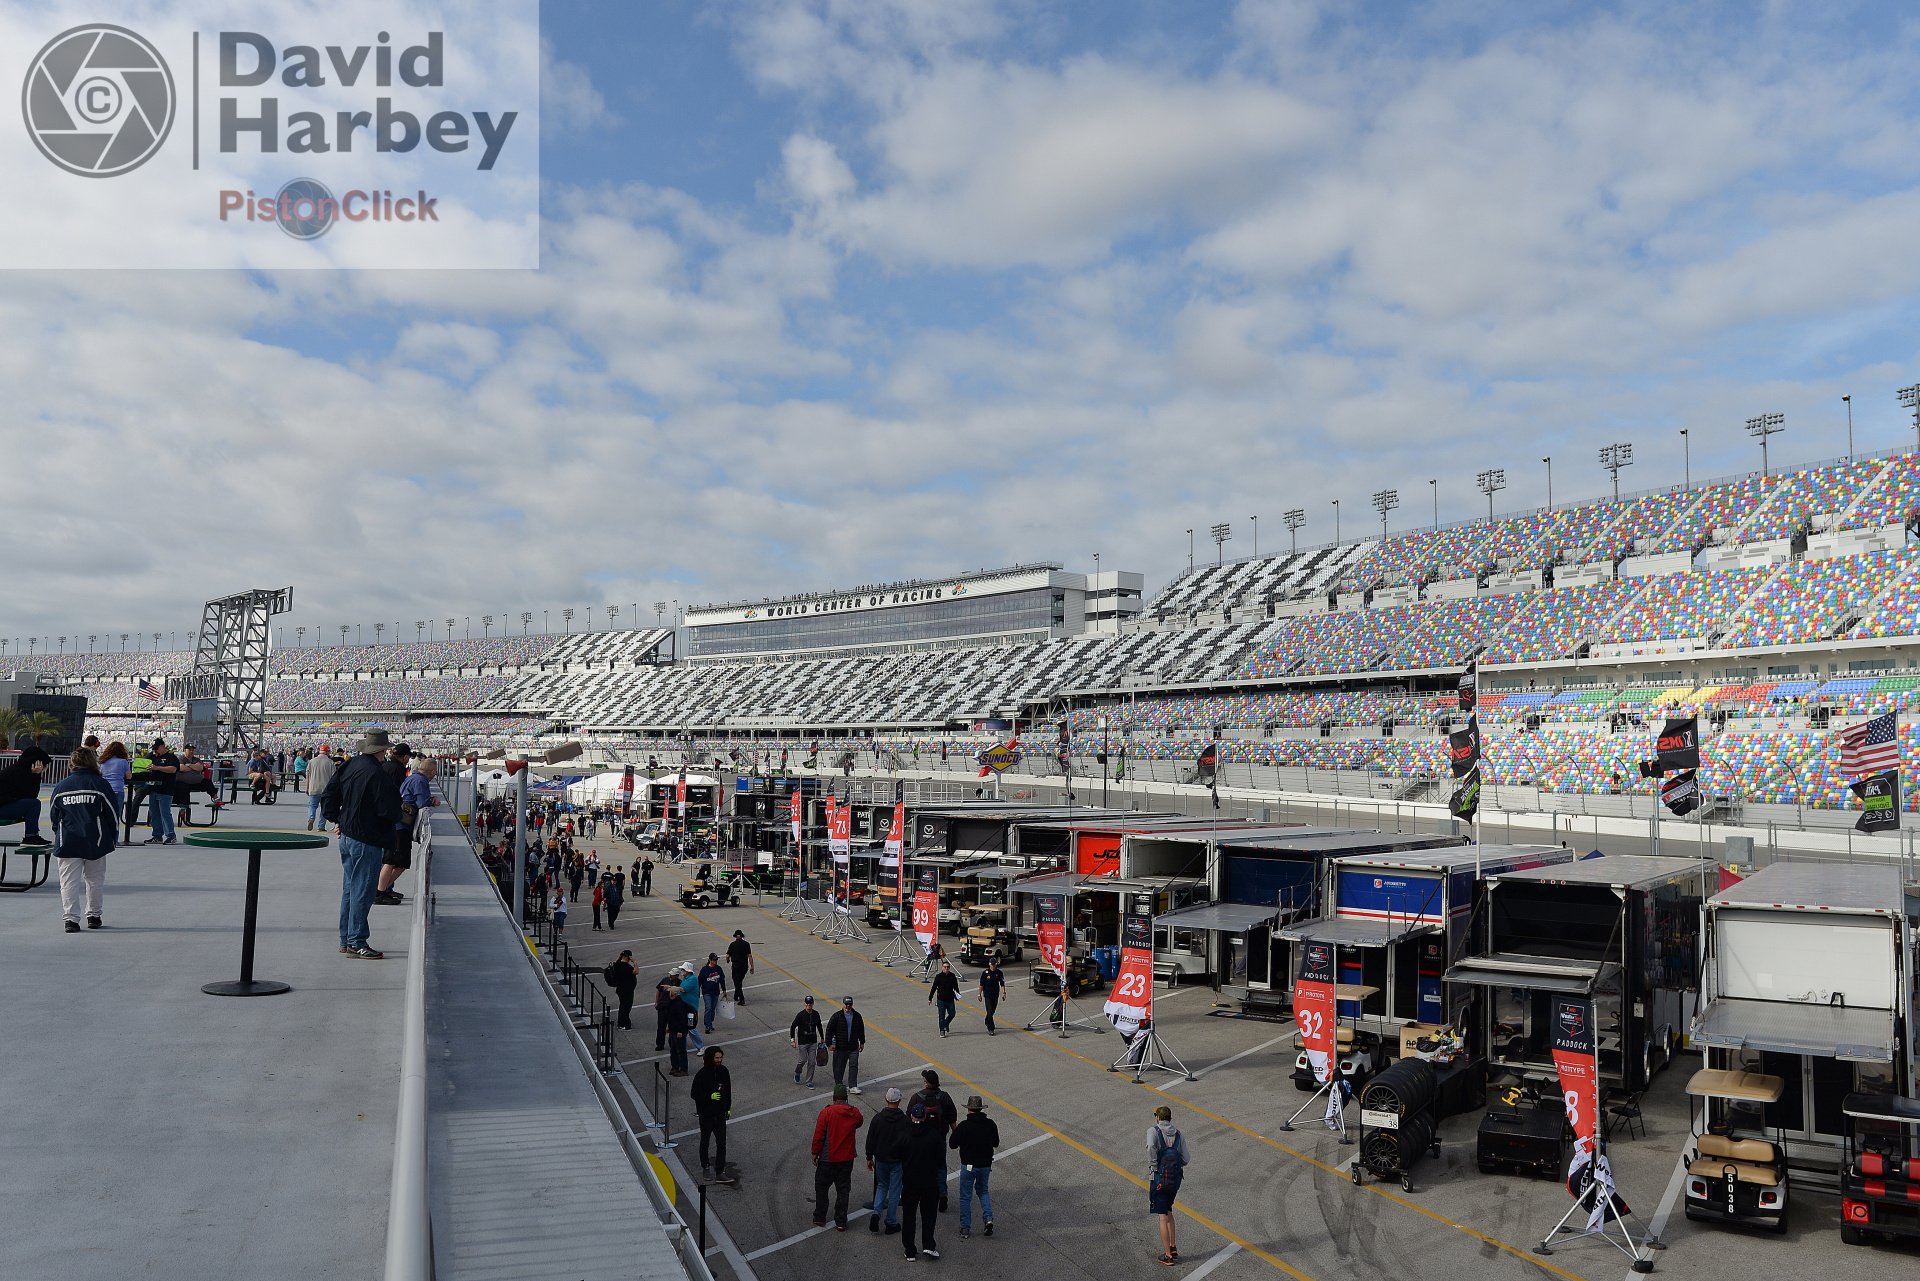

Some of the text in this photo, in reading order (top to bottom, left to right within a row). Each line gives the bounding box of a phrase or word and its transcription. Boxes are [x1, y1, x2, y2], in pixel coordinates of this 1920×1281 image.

[768, 589, 942, 617] WORLD CENTER OF RACING
[981, 753, 1020, 764] SUNOCO
[62, 795, 96, 805] SECURITY
[1093, 850, 1120, 859] JD
[913, 908, 929, 927] 99
[1118, 972, 1146, 998] 23
[1299, 1009, 1323, 1040] 32
[1556, 1038, 1588, 1050] PADDOCK
[1388, 1120, 1398, 1128] 38
